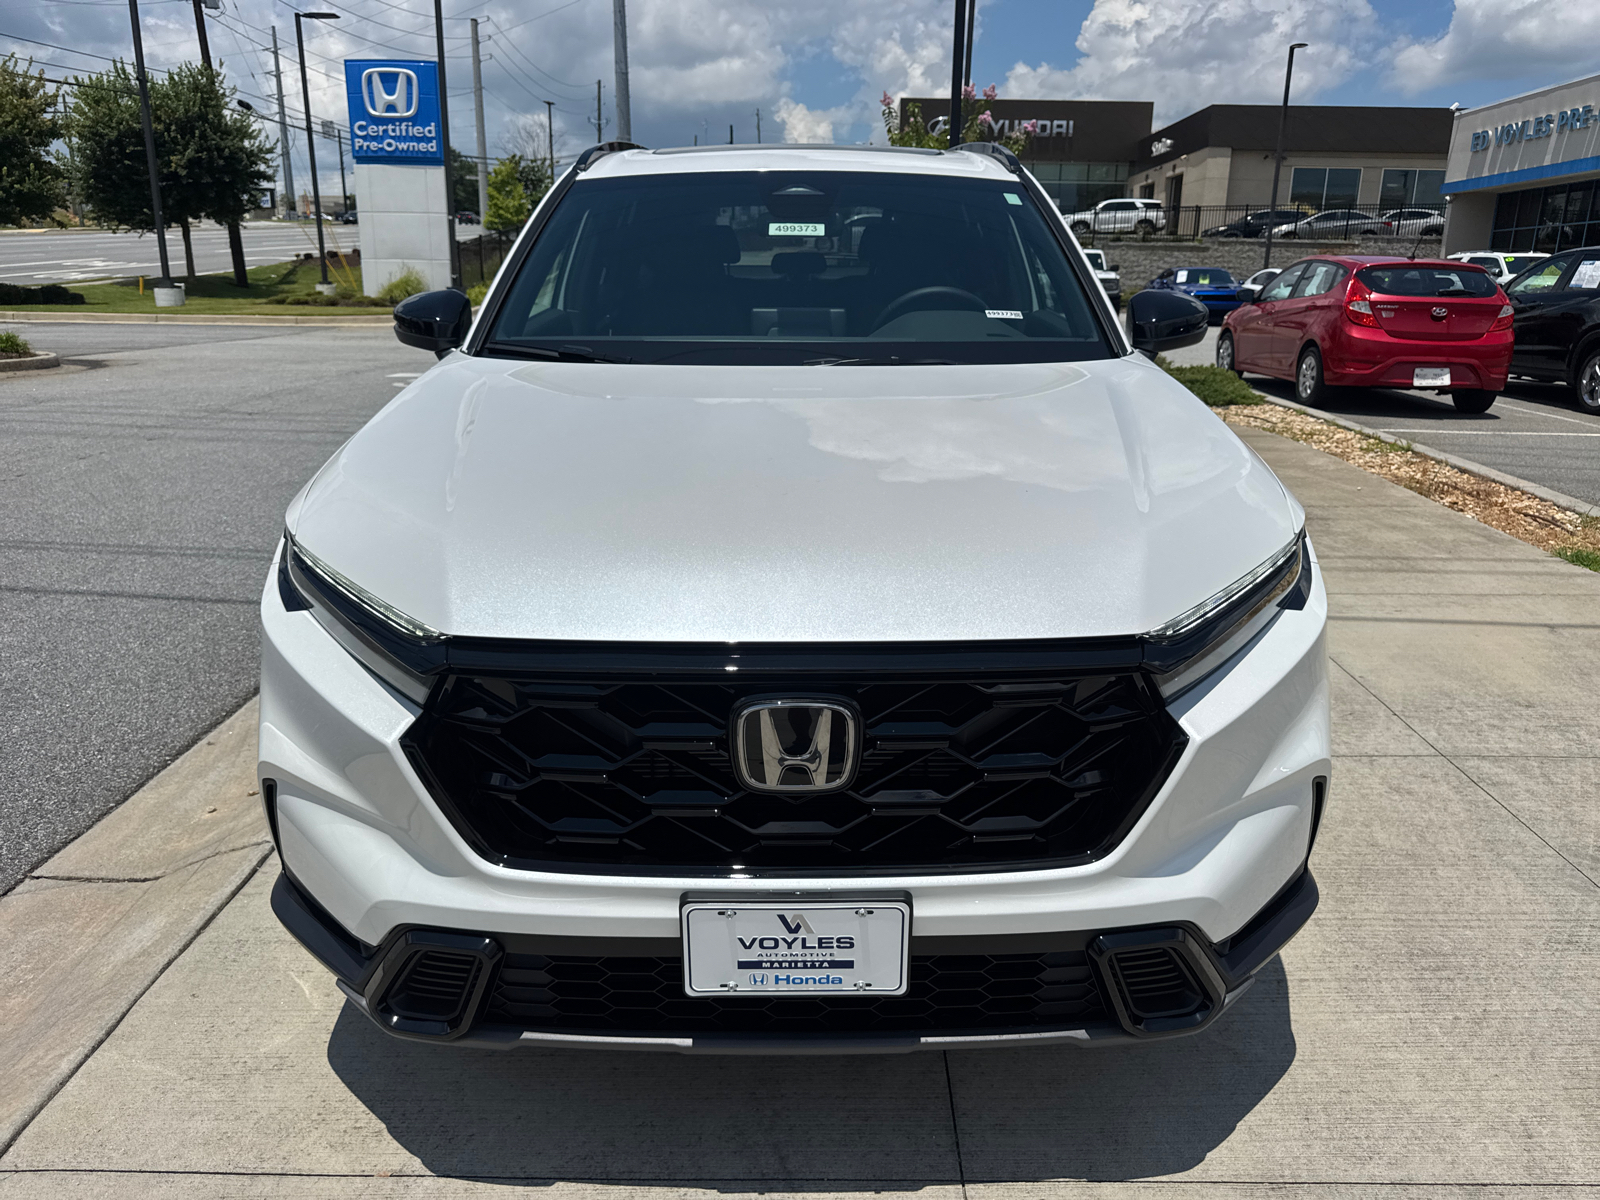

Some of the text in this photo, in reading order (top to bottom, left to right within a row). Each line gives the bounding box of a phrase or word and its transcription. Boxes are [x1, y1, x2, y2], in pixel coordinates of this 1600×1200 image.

[353, 121, 436, 137] Certified
[984, 118, 1074, 137] YUDAI
[1470, 104, 1600, 152] ED VOYLES PRE-
[353, 138, 437, 152] Pre-Owned
[774, 224, 818, 233] 499373
[737, 935, 855, 950] VOYLES
[774, 974, 843, 985] Honda
